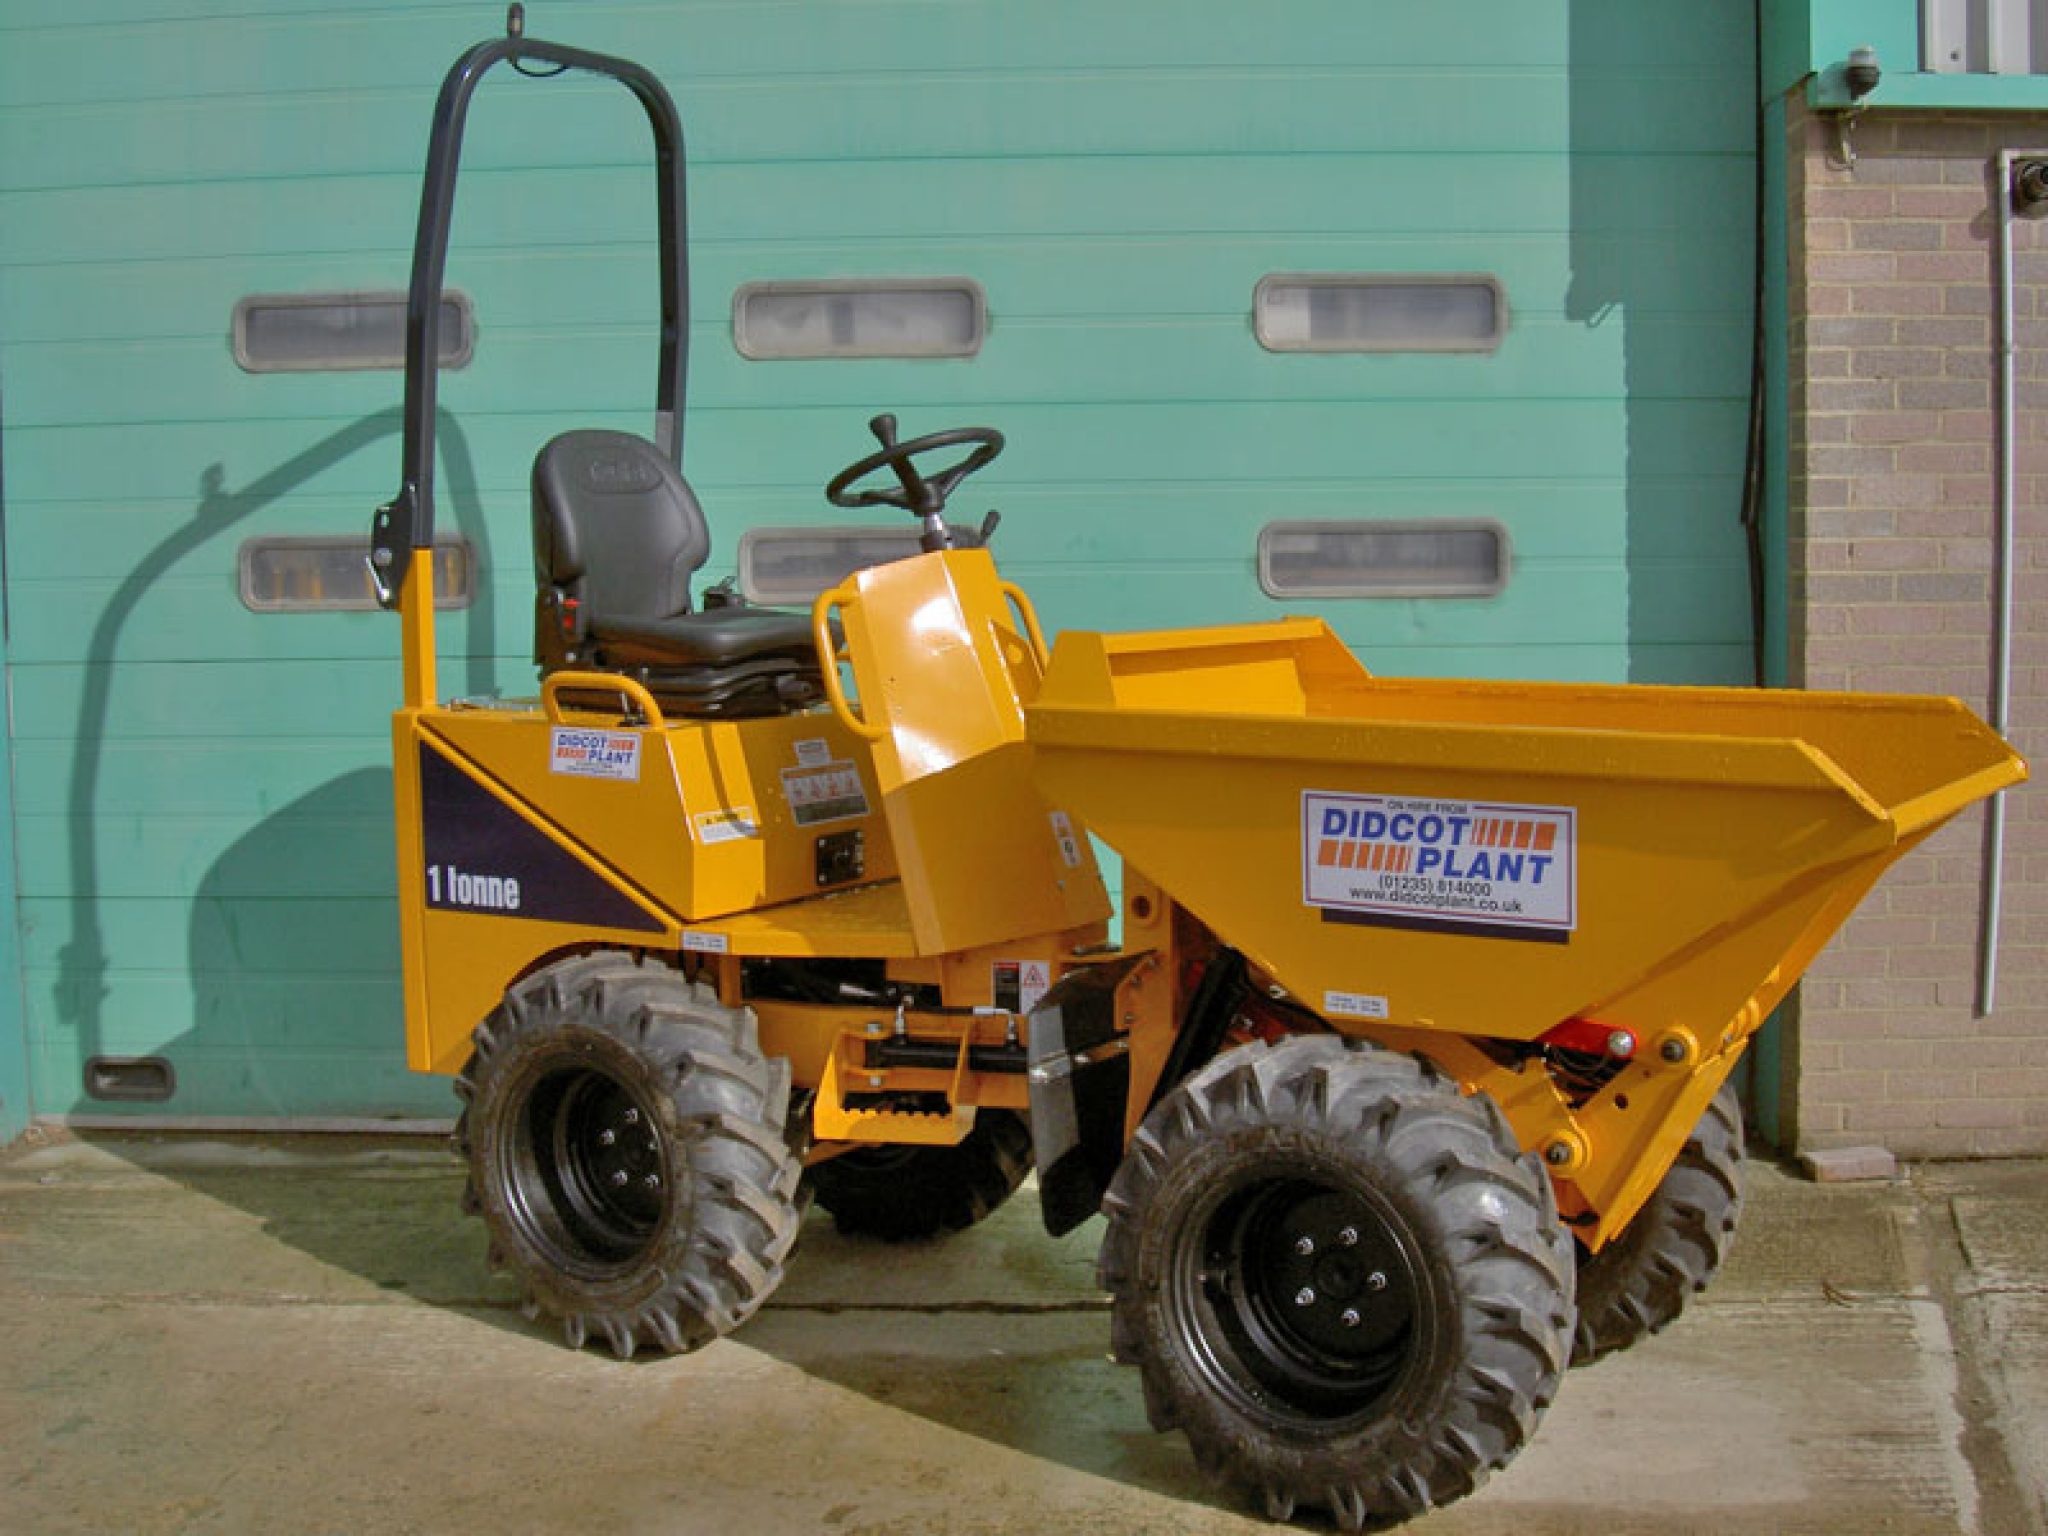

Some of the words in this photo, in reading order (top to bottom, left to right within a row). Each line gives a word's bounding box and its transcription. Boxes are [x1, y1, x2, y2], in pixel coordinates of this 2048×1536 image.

[589, 749, 633, 764] PLANT
[1321, 807, 1471, 846] DIDCOT
[1379, 875, 1433, 893] (01235)
[1415, 847, 1553, 884] PLANT
[427, 865, 440, 902] 1
[447, 865, 520, 909] tonne
